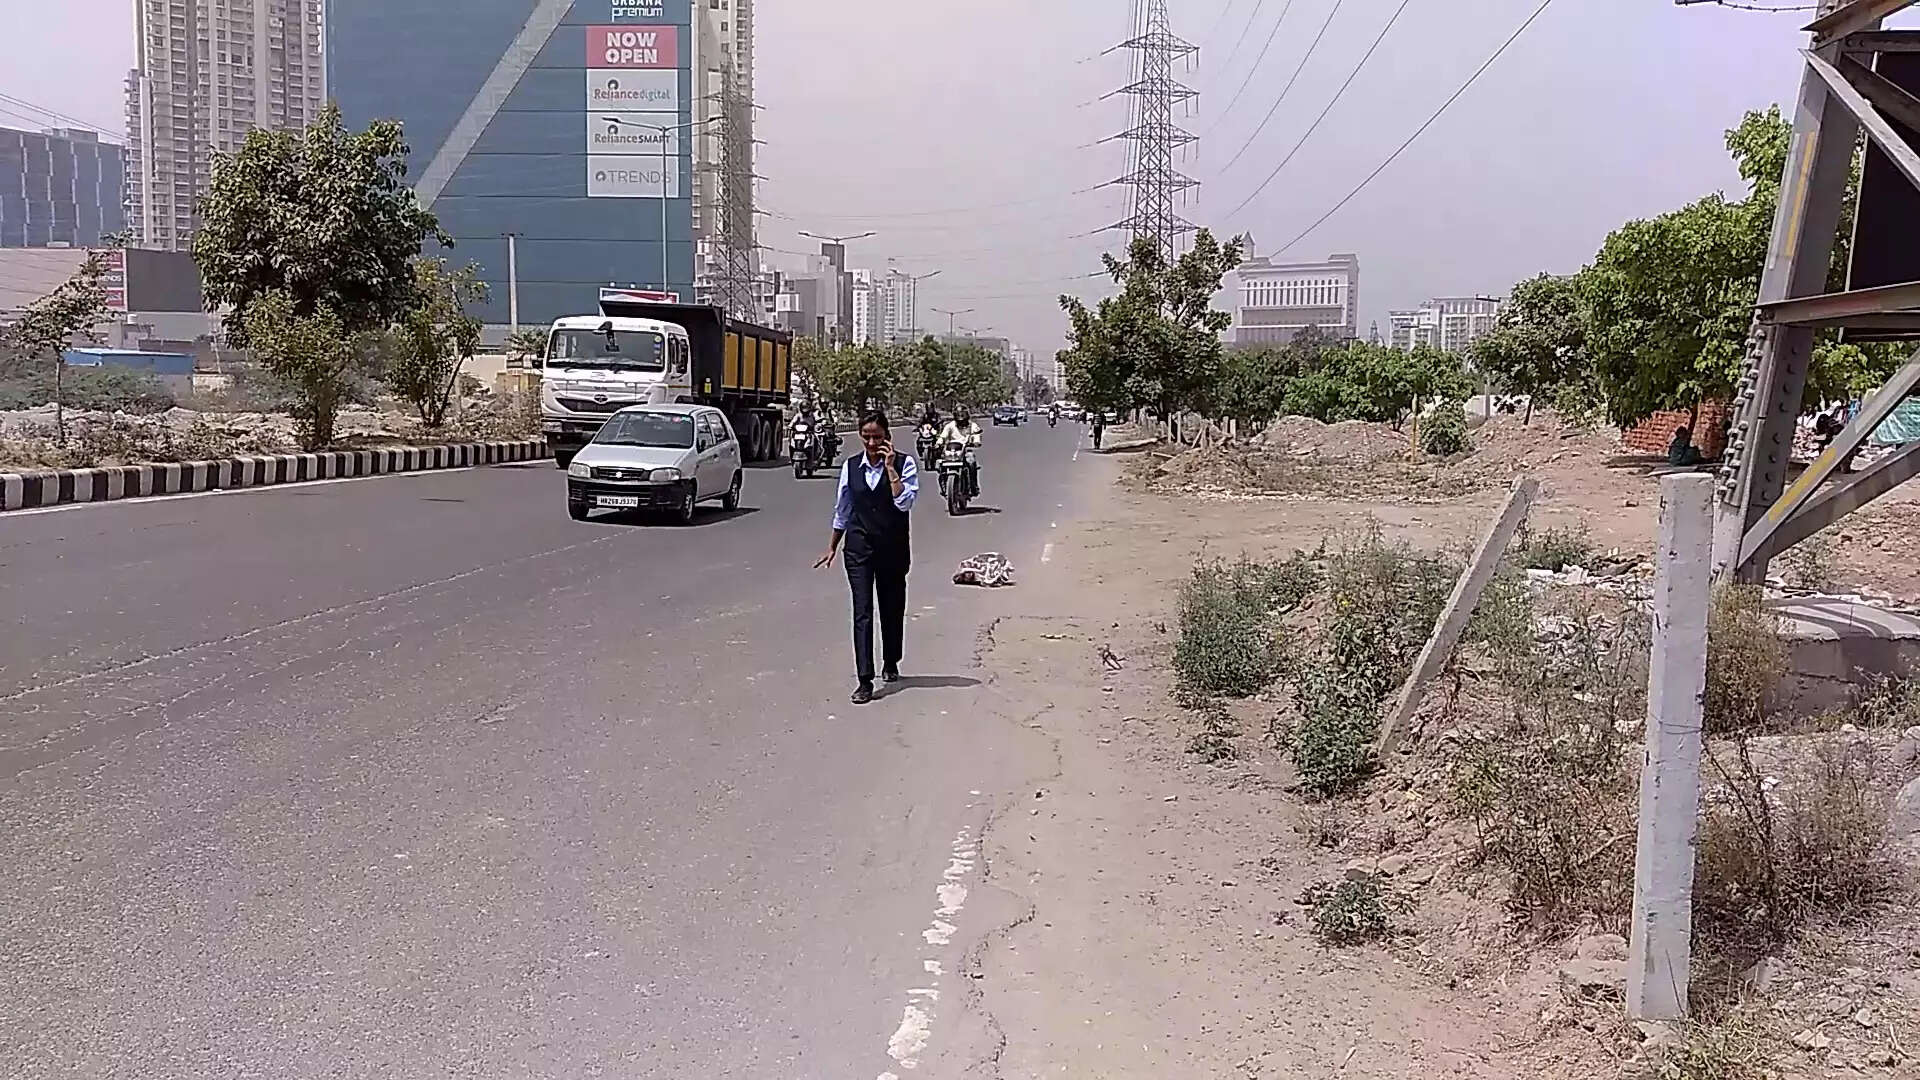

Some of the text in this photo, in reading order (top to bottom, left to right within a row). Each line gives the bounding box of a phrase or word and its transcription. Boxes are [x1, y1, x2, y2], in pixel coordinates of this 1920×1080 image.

[611, 7, 663, 23] premium
[607, 31, 657, 48] NOW
[605, 48, 658, 64] OPEN
